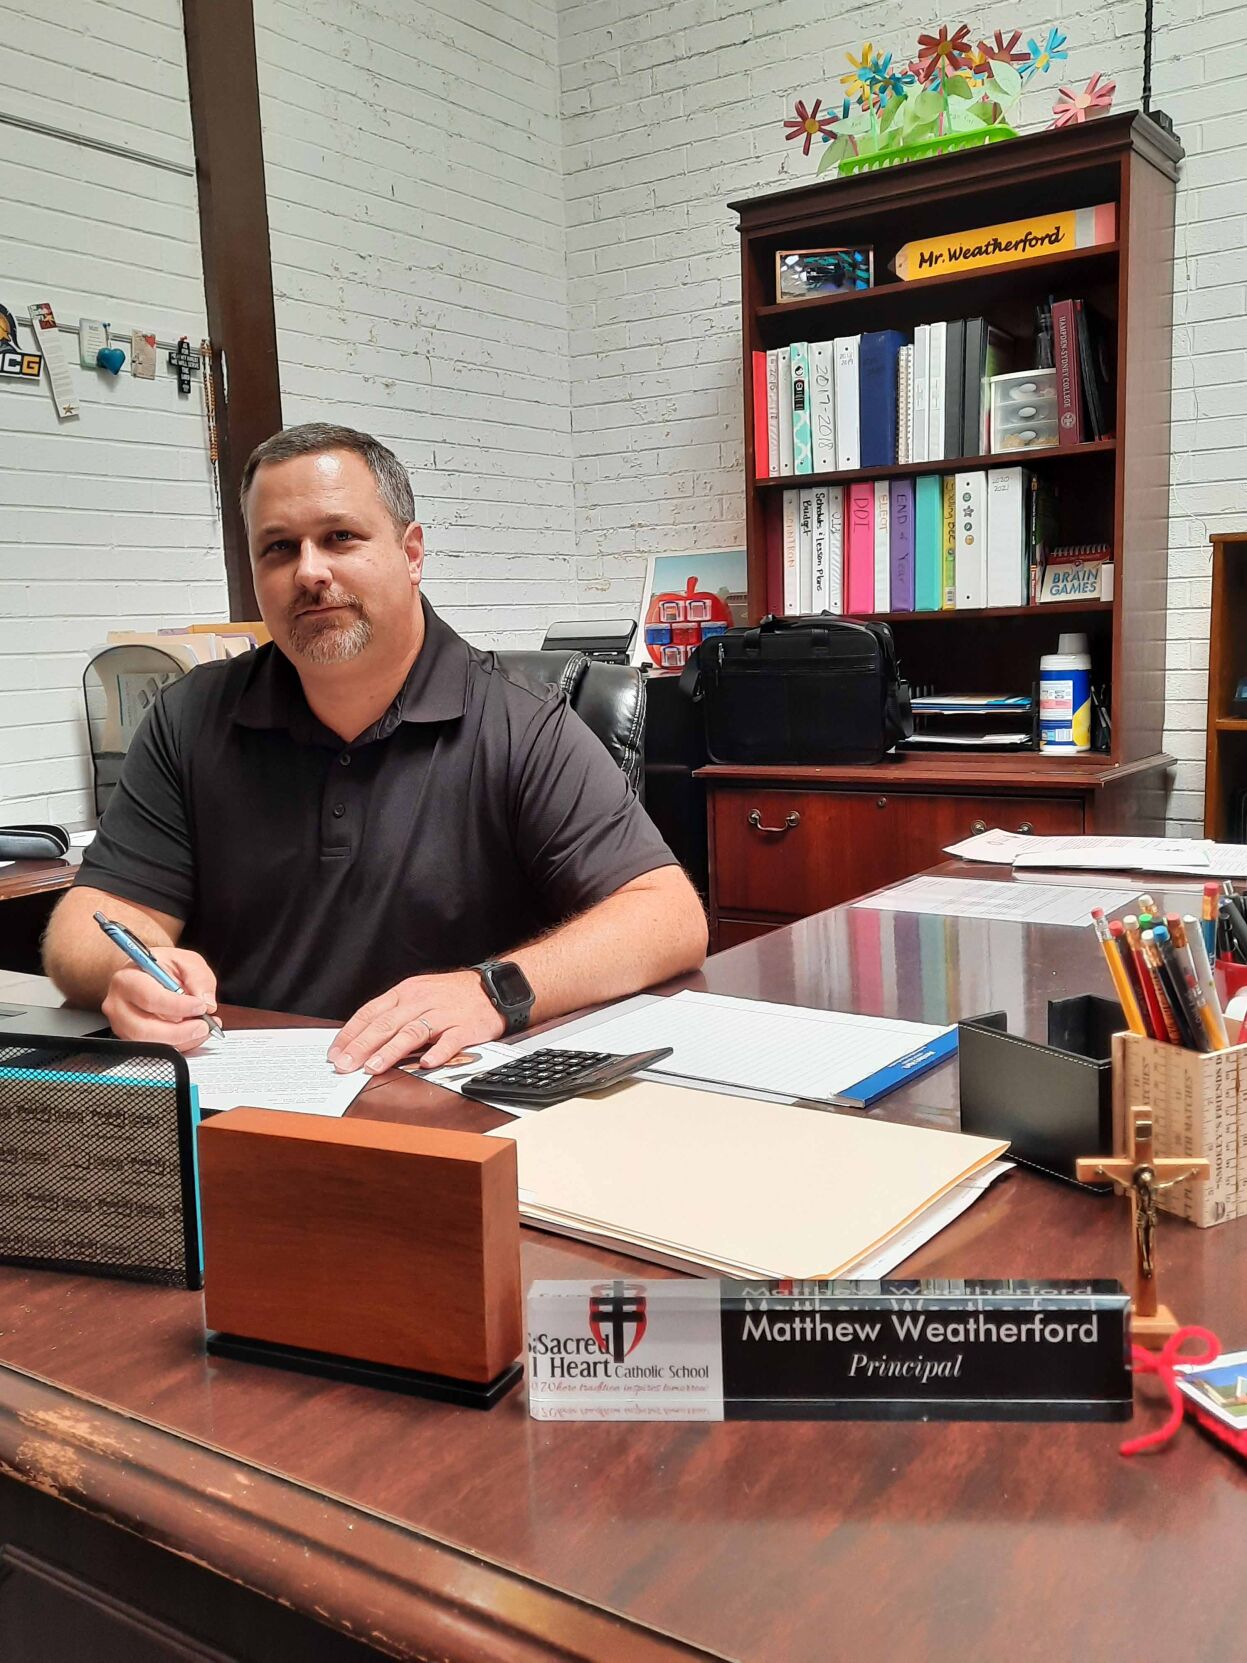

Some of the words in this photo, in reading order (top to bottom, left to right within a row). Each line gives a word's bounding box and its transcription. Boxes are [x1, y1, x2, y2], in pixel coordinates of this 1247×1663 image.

[918, 250, 945, 269] Mr.
[948, 226, 1066, 263] Weatherford
[0, 353, 40, 375] CG
[816, 364, 834, 451] 2017-2018
[1062, 377, 1071, 408] COLLEGE
[801, 499, 812, 537] Budget
[897, 494, 908, 525] END
[1049, 580, 1098, 596] GAMES
[1051, 566, 1099, 585] BRAIN
[1215, 1068, 1223, 1119] FRIENDS
[537, 1333, 610, 1355] Sacred
[741, 1314, 881, 1342] Matthew
[891, 1314, 1099, 1343] Weatherford
[550, 1357, 612, 1379] Heart
[614, 1365, 665, 1379] Catholic
[669, 1364, 709, 1379] School
[848, 1353, 963, 1384] Principal
